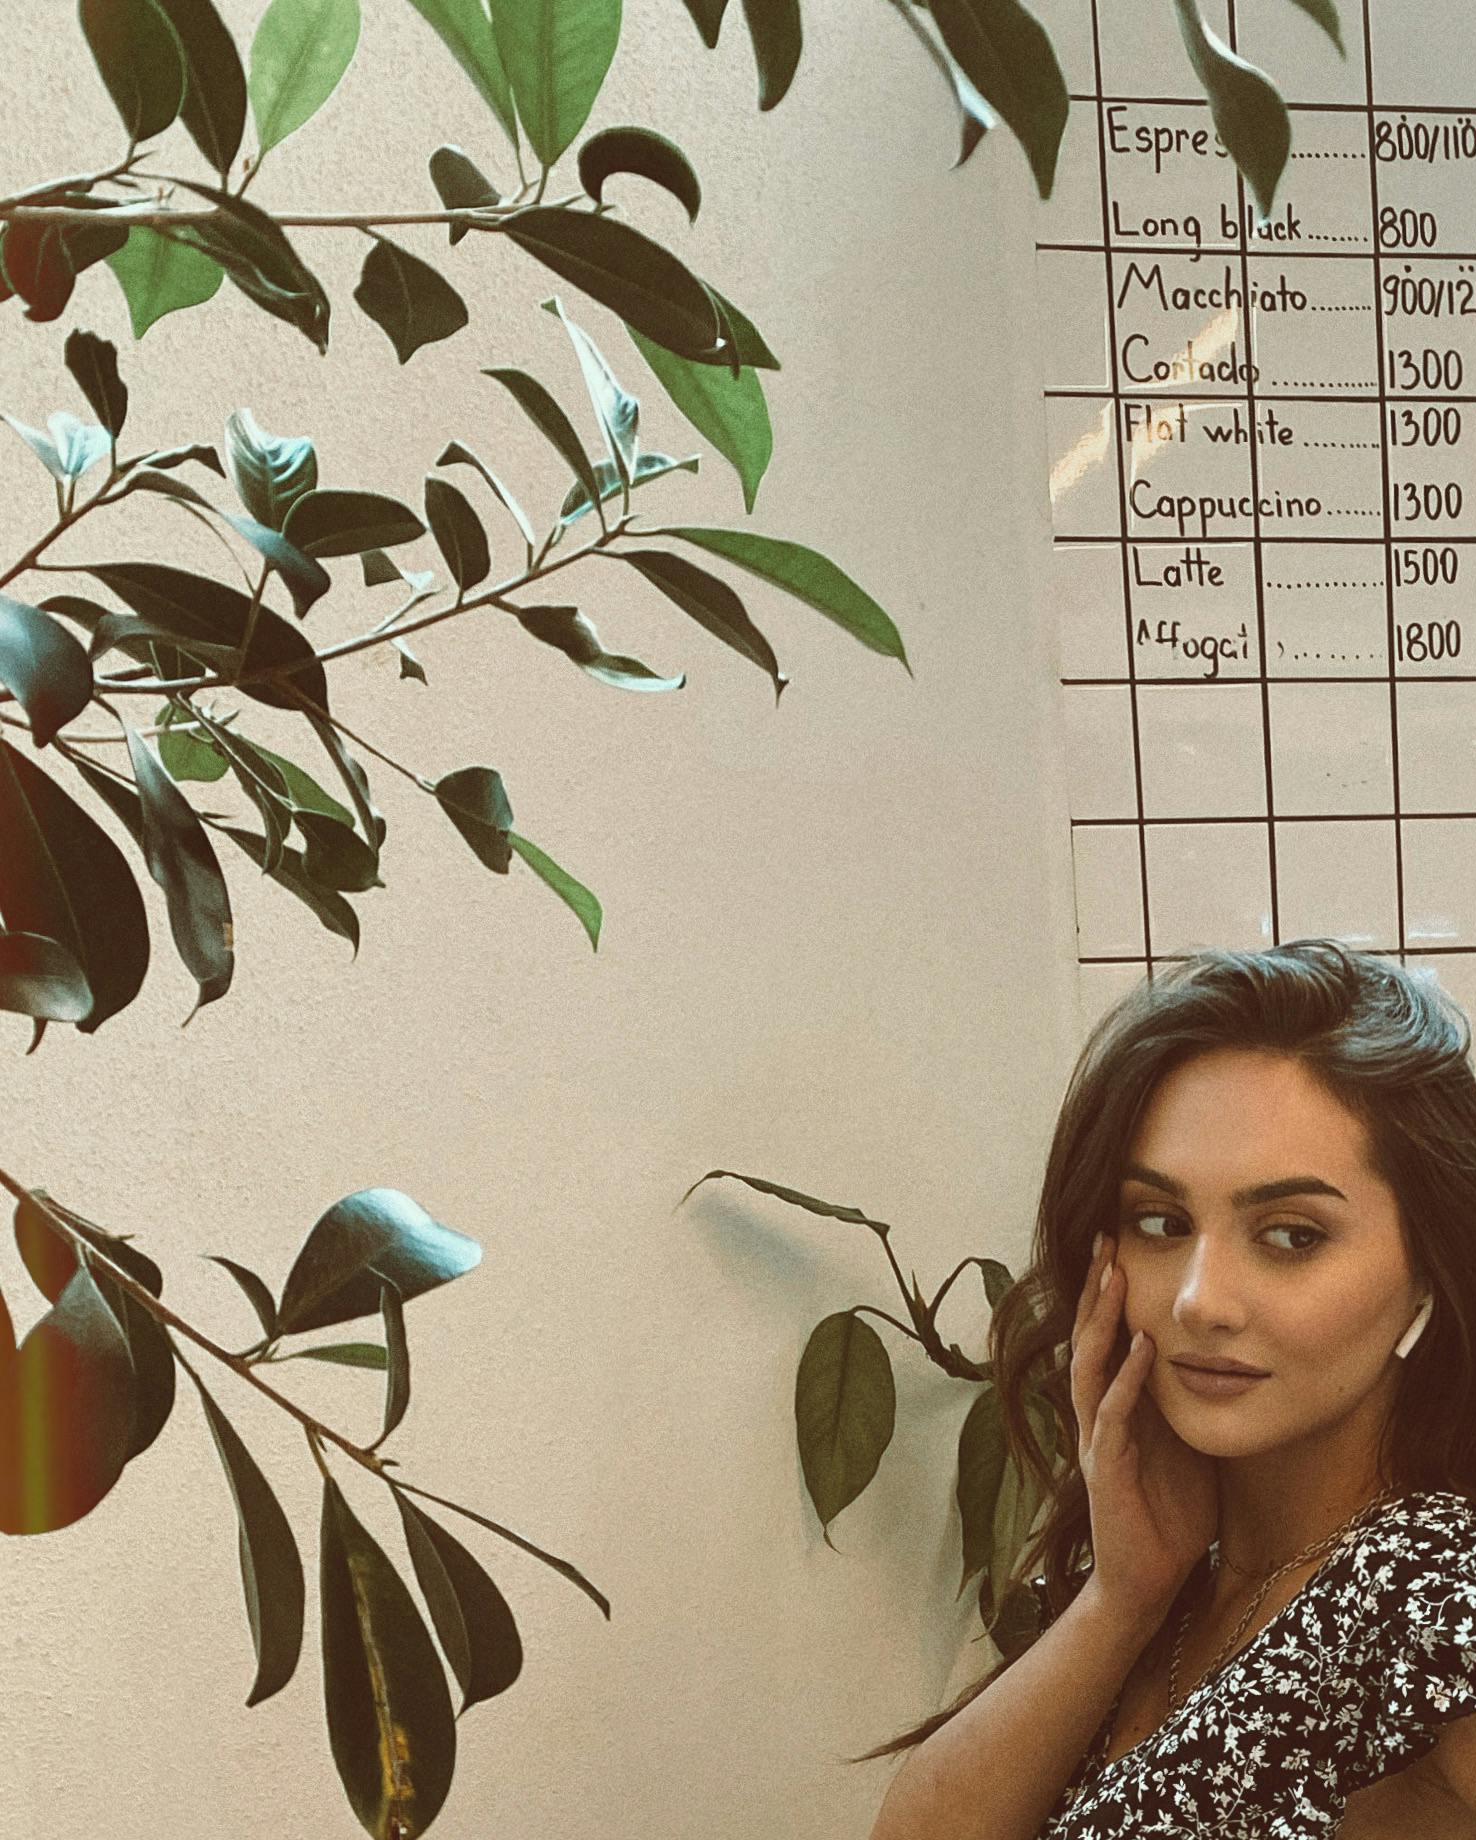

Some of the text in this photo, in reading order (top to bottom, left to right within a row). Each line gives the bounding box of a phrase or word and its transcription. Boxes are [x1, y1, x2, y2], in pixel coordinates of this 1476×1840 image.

[1113, 201, 1437, 262] Long black 800
[1118, 263, 1308, 313] Macchiato
[1121, 333, 1463, 391] Cortado 1300
[1124, 403, 1462, 447] Flat white 1300
[1129, 480, 1463, 538] Cappuccino 1300
[1132, 546, 1459, 587] Latte 1500
[1396, 620, 1462, 662] 1800
